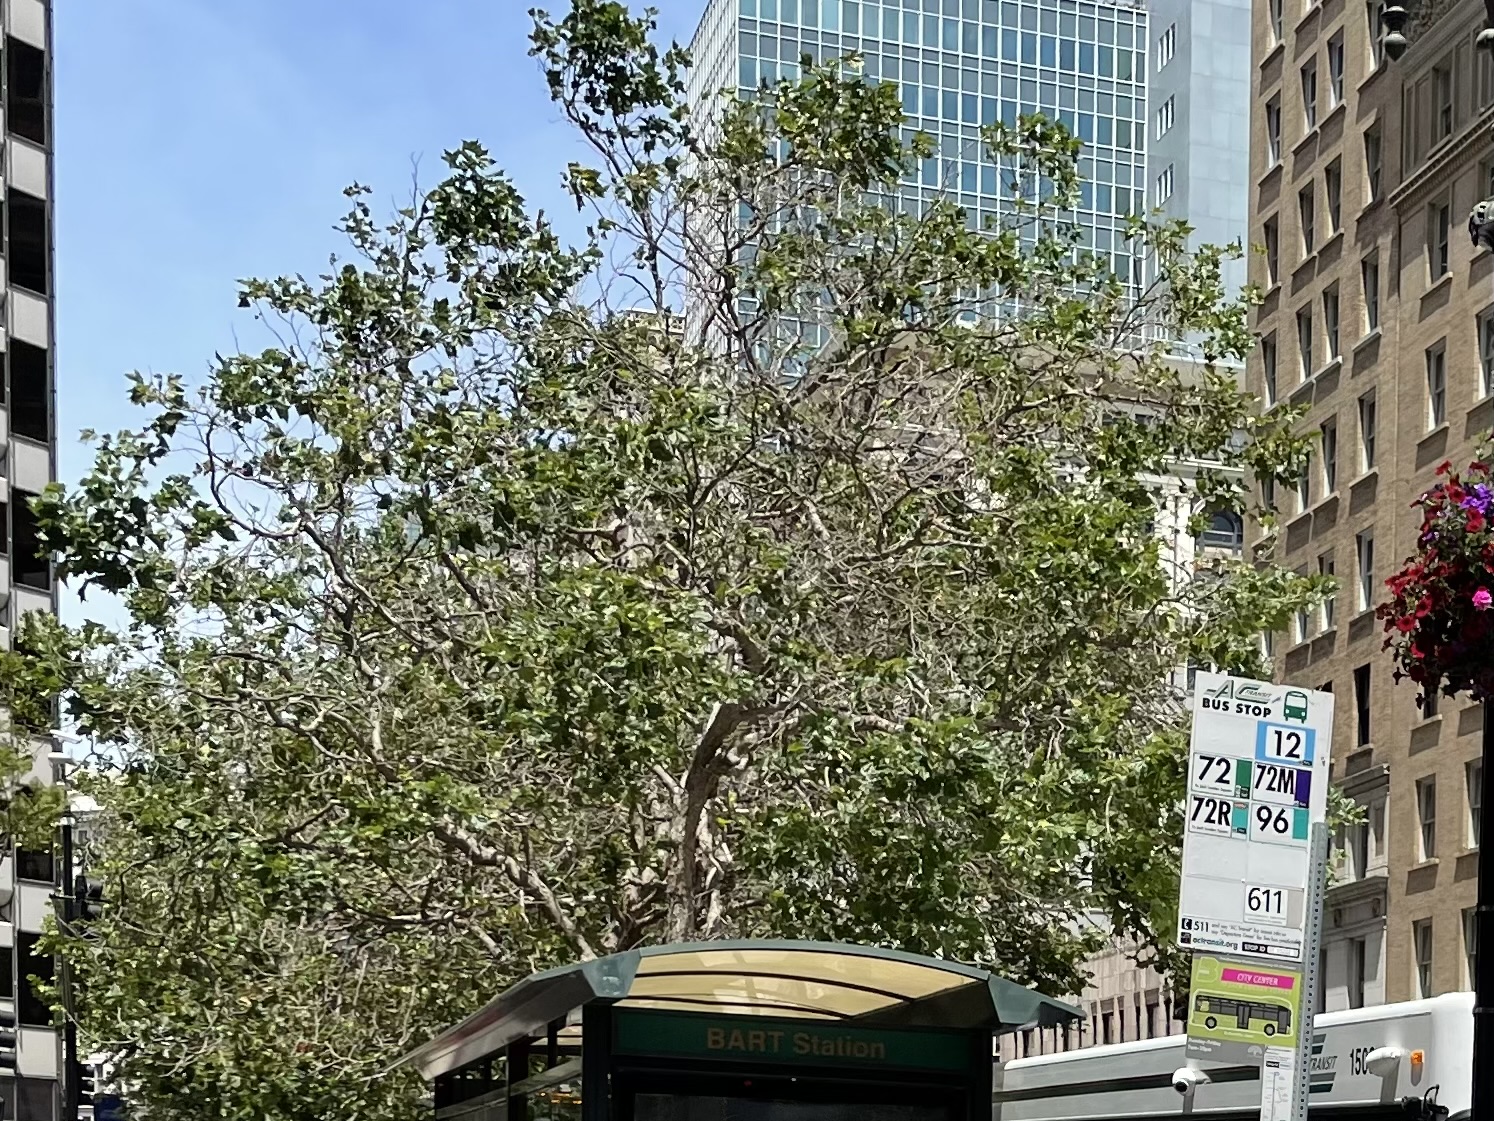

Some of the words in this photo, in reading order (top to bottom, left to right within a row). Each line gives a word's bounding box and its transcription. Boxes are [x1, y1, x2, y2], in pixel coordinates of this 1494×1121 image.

[1203, 679, 1271, 704] AC
[1202, 697, 1230, 712] BUS
[1235, 703, 1272, 718] STOP
[1274, 729, 1301, 759] 12
[1198, 755, 1231, 785] 72
[1254, 764, 1295, 795] 72M
[1191, 795, 1232, 827] 72R
[1256, 805, 1289, 834] 96
[1247, 887, 1282, 914] 611
[1193, 920, 1209, 932] 511
[1236, 972, 1253, 983] CITY
[1253, 974, 1279, 986] CENTER
[707, 1027, 784, 1051] BART
[792, 1032, 886, 1059] Station
